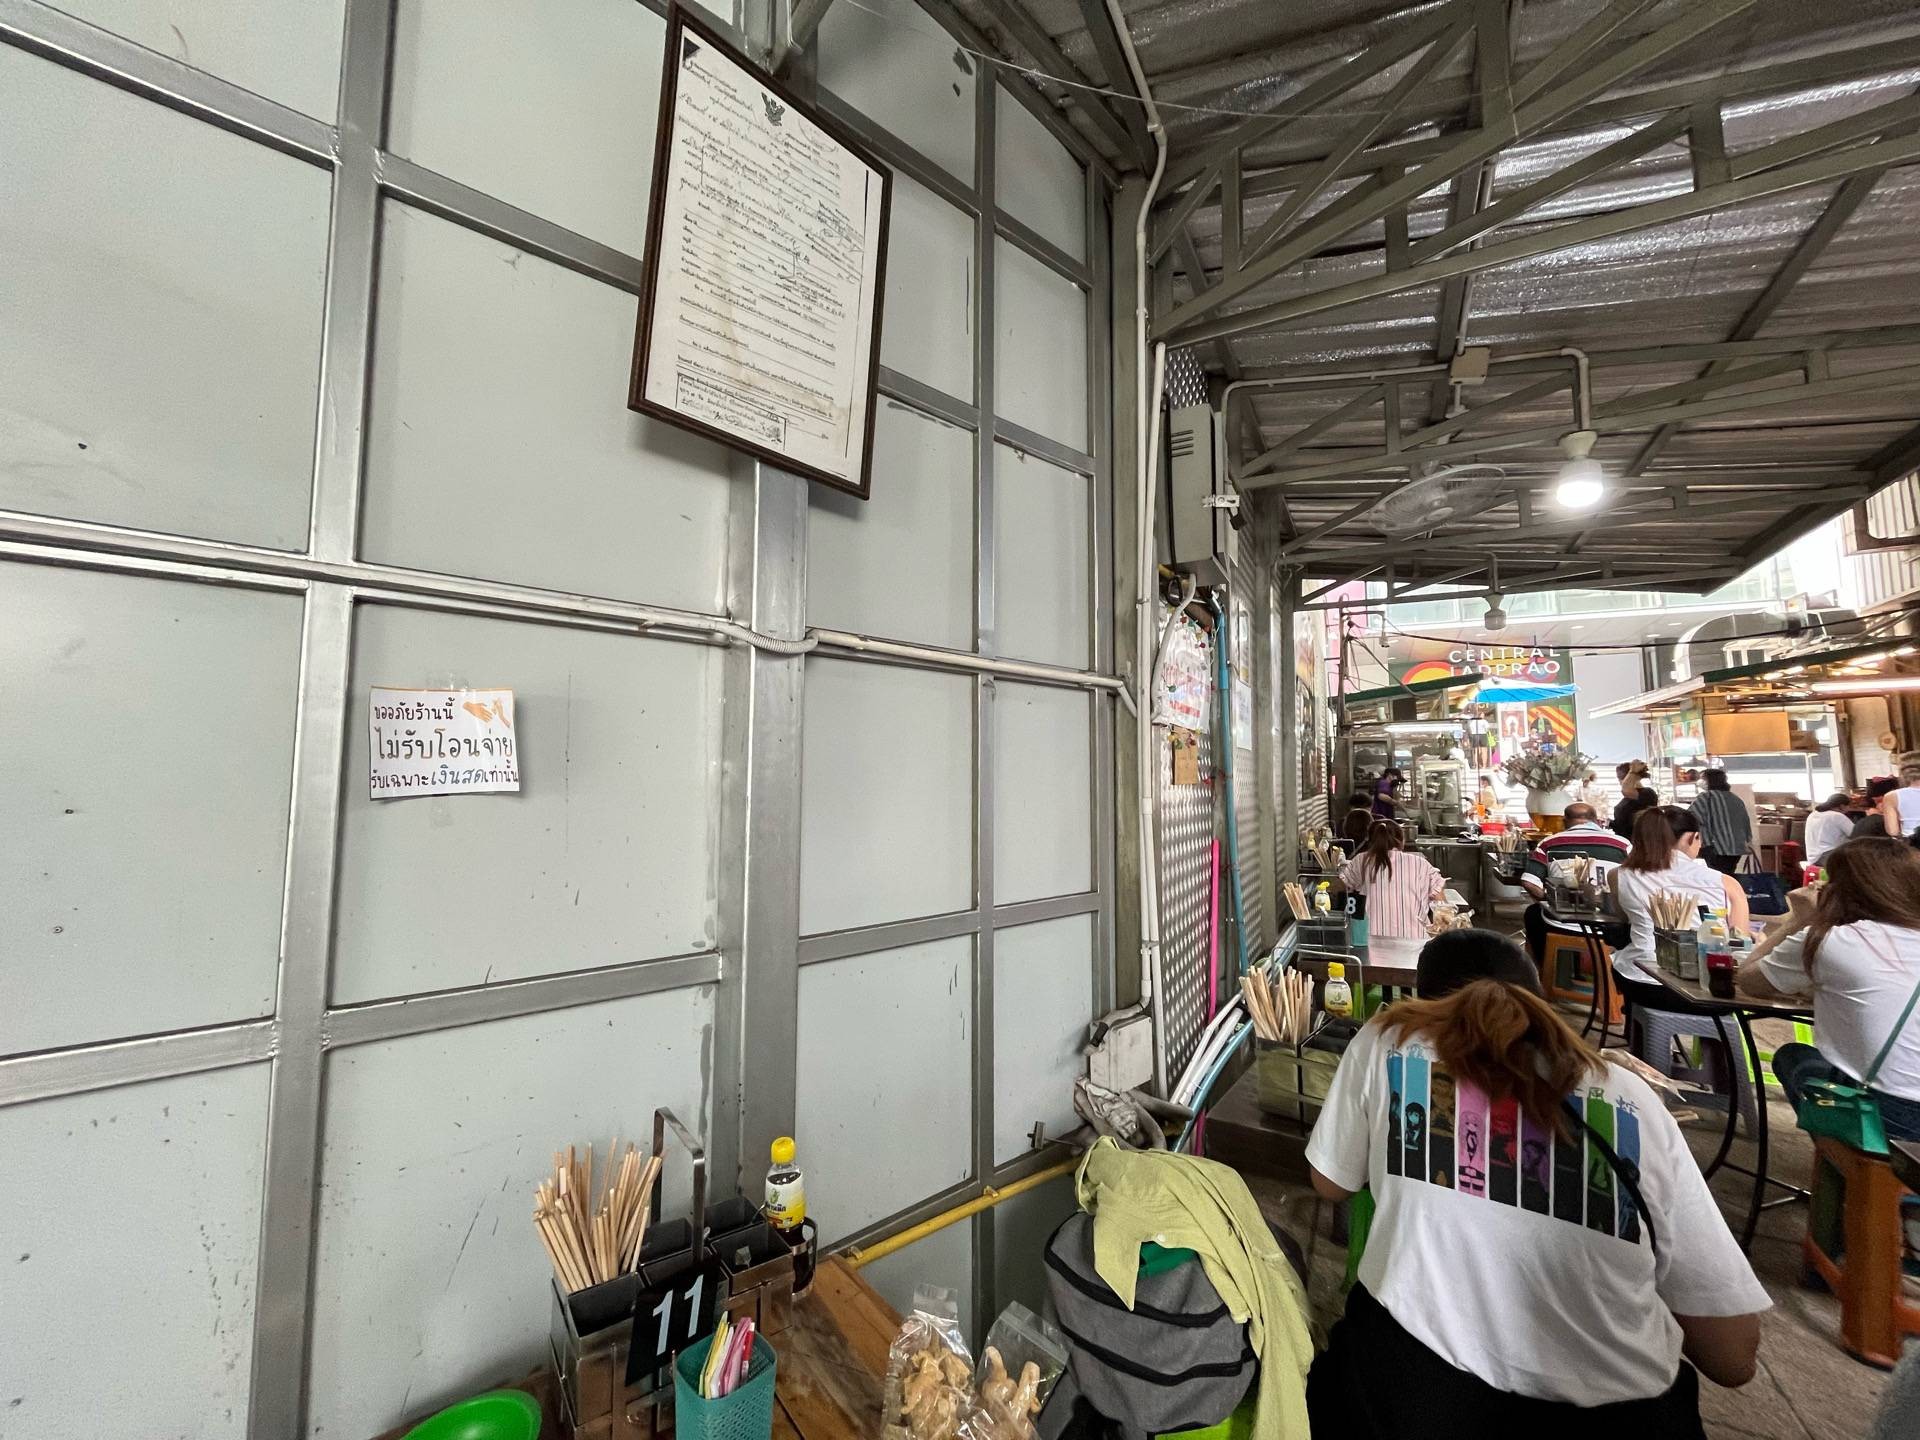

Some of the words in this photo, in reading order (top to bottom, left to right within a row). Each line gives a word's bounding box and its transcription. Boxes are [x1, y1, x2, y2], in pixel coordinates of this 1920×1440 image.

[1449, 644, 1561, 663] CENTRAL
[374, 697, 455, 720] ขออภัยร้านนี้
[374, 727, 513, 759] ไม่รับโอนจ่าย
[1346, 896, 1357, 915] 8
[652, 1273, 704, 1357] 11
